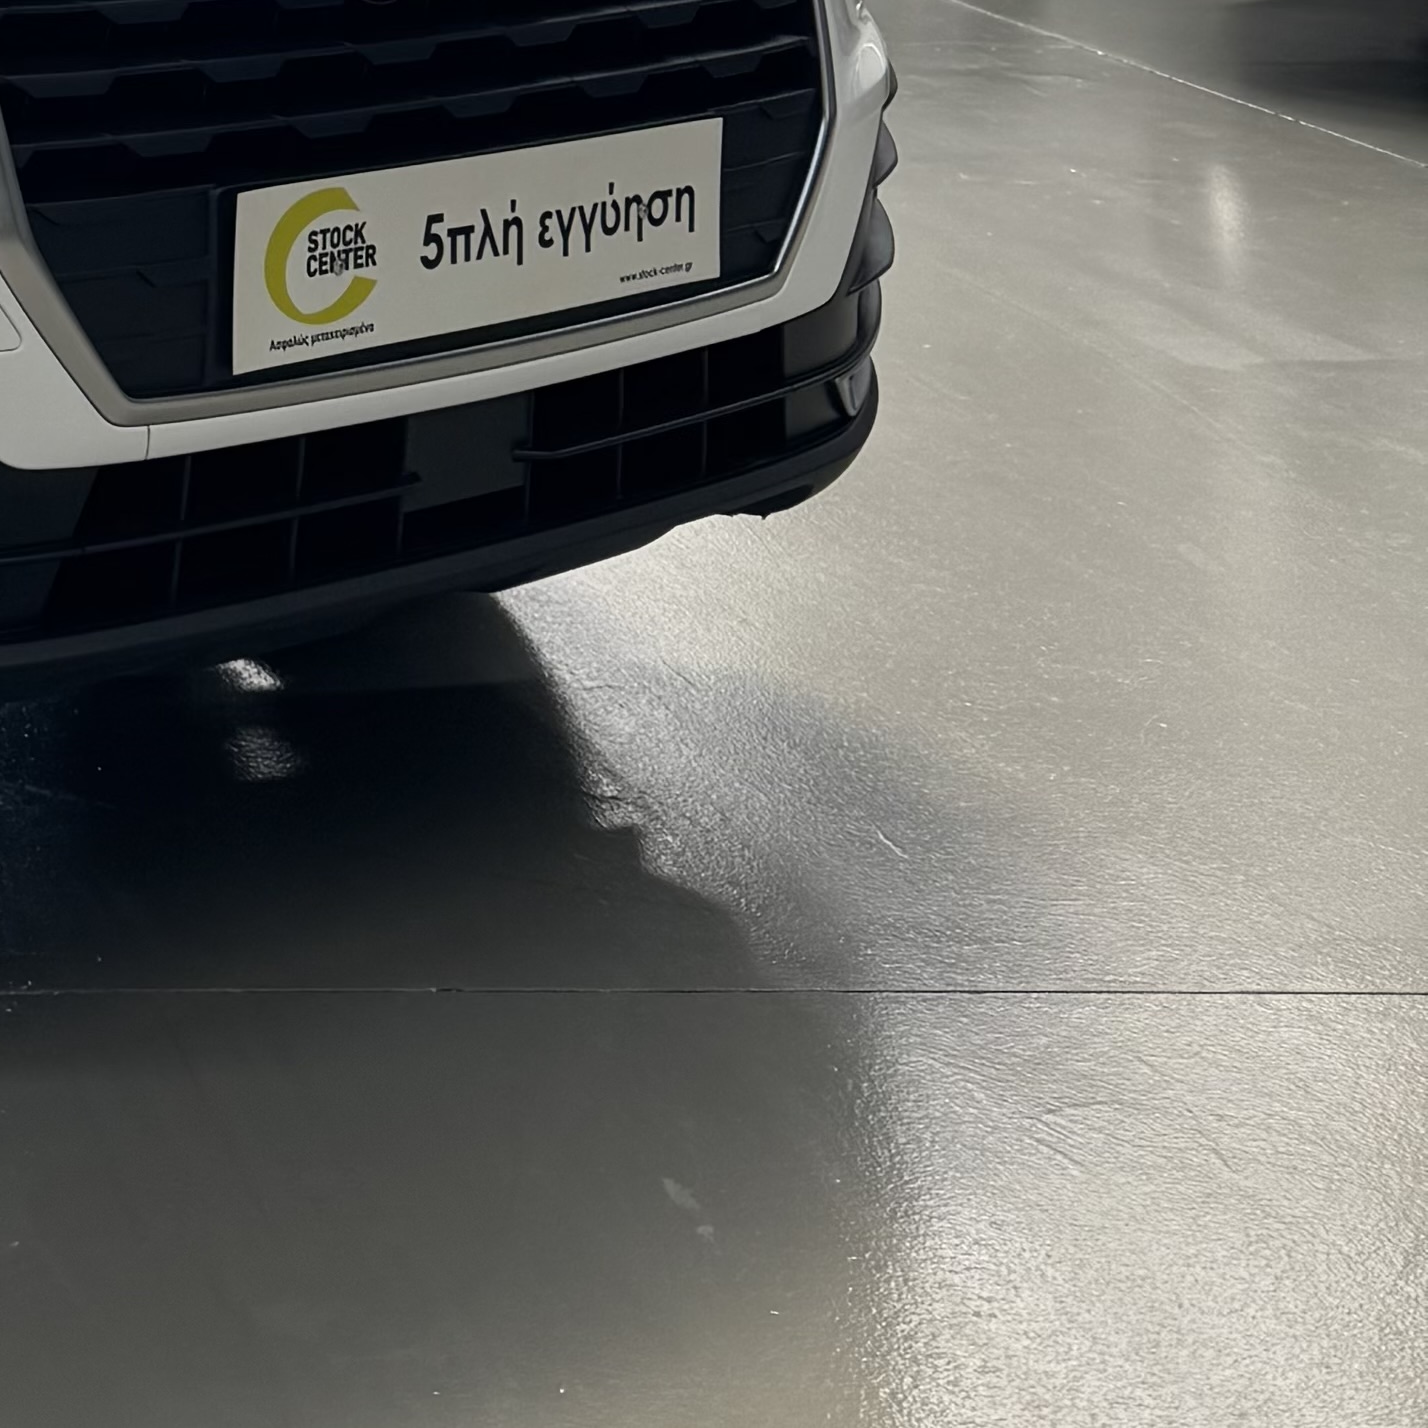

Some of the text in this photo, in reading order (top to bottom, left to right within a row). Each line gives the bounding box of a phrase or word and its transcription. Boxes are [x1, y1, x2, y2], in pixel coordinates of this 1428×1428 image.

[307, 221, 367, 253] STOCK
[420, 182, 695, 270] 5πλή εγγύηση
[306, 244, 377, 278] CENTER
